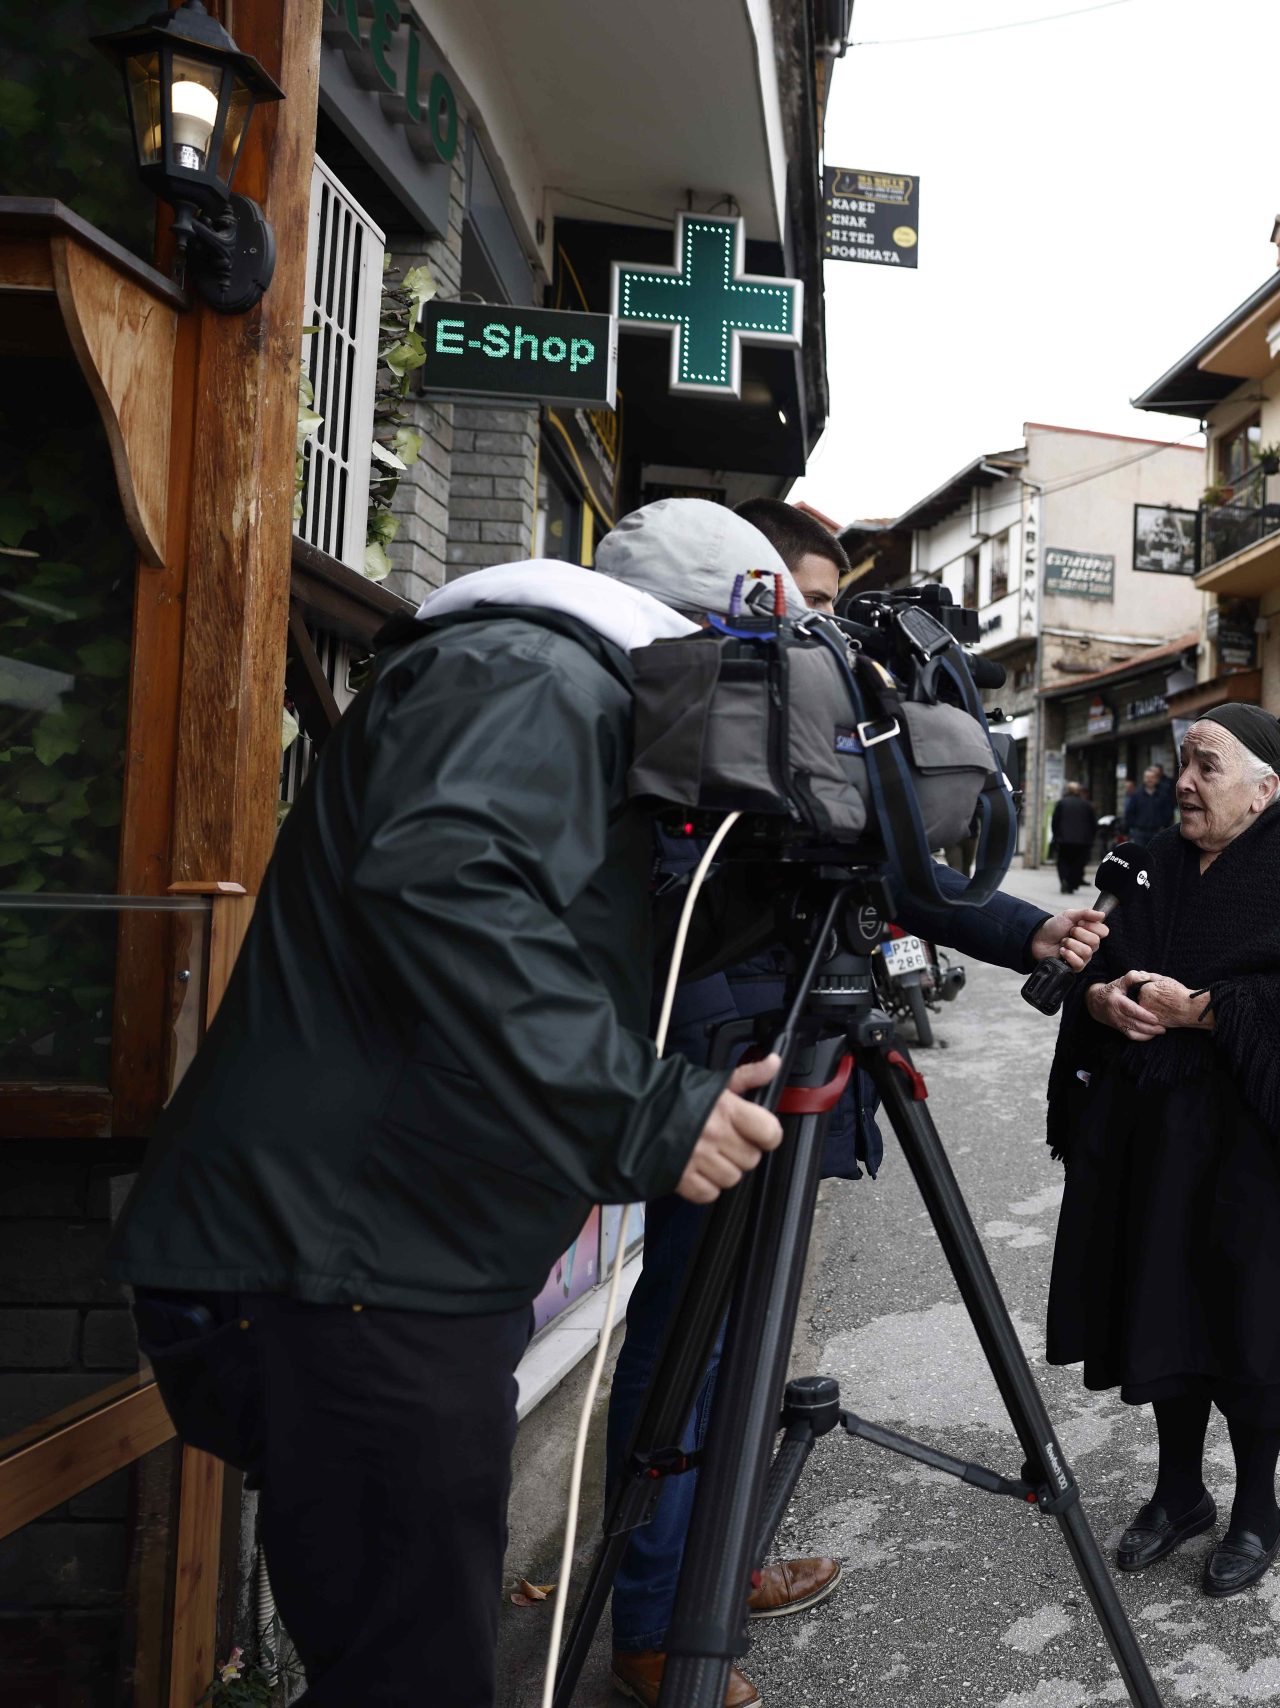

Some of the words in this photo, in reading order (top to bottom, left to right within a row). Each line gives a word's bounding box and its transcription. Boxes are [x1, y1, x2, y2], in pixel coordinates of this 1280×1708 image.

[832, 198, 875, 214] ΚΑΦΕΣ
[831, 229, 875, 245] ΠΙΤΕΣ
[831, 245, 900, 263] ΡΟΦΗΜΑΤΑ
[435, 318, 595, 372] E-Shop
[1109, 855, 1130, 870] news.
[897, 954, 924, 970] 286
